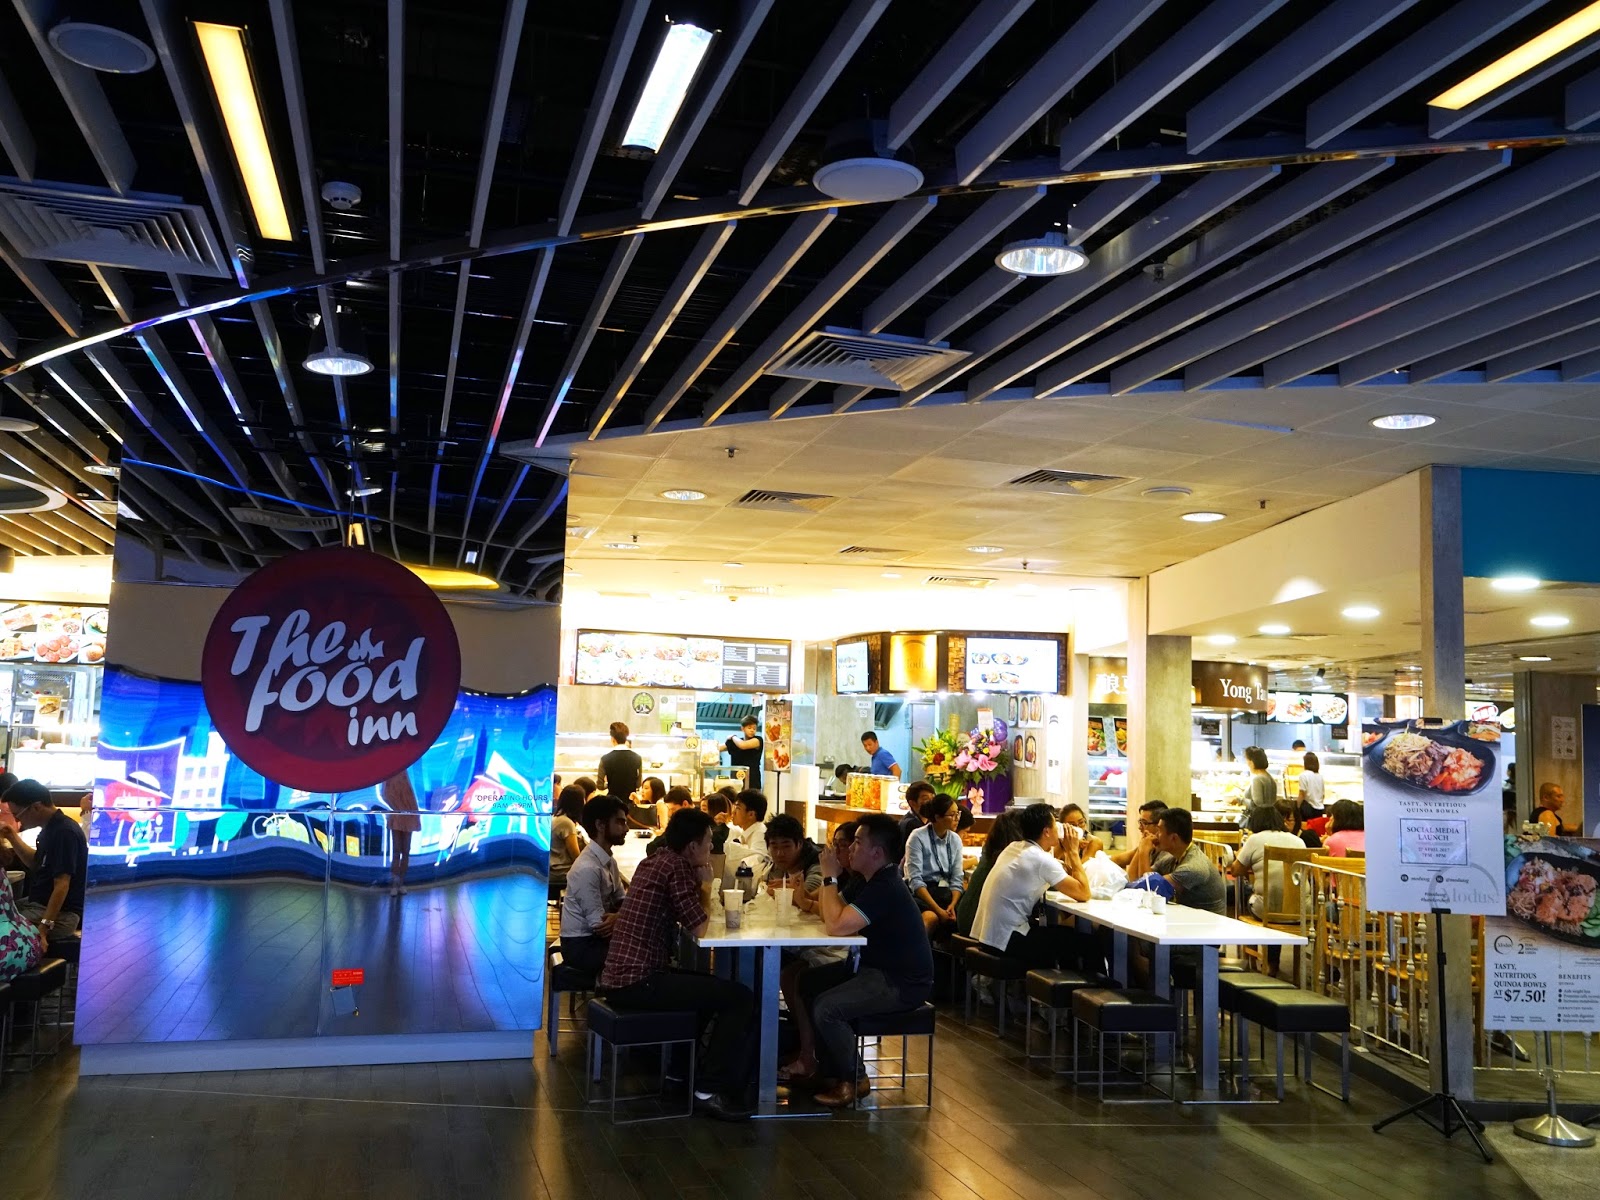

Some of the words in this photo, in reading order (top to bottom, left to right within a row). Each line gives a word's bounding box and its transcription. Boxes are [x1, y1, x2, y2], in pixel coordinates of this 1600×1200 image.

[230, 609, 347, 676] The
[245, 637, 426, 732] food
[1219, 678, 1253, 705] Yong
[347, 706, 419, 746] inn
[477, 794, 521, 802] OPERATING
[1406, 826, 1435, 834] SOCIAL
[1517, 943, 1525, 955] 2
[1494, 963, 1517, 971] TASTY,
[1493, 980, 1522, 988] QUINOA
[1504, 988, 1546, 1003] $7.50!
